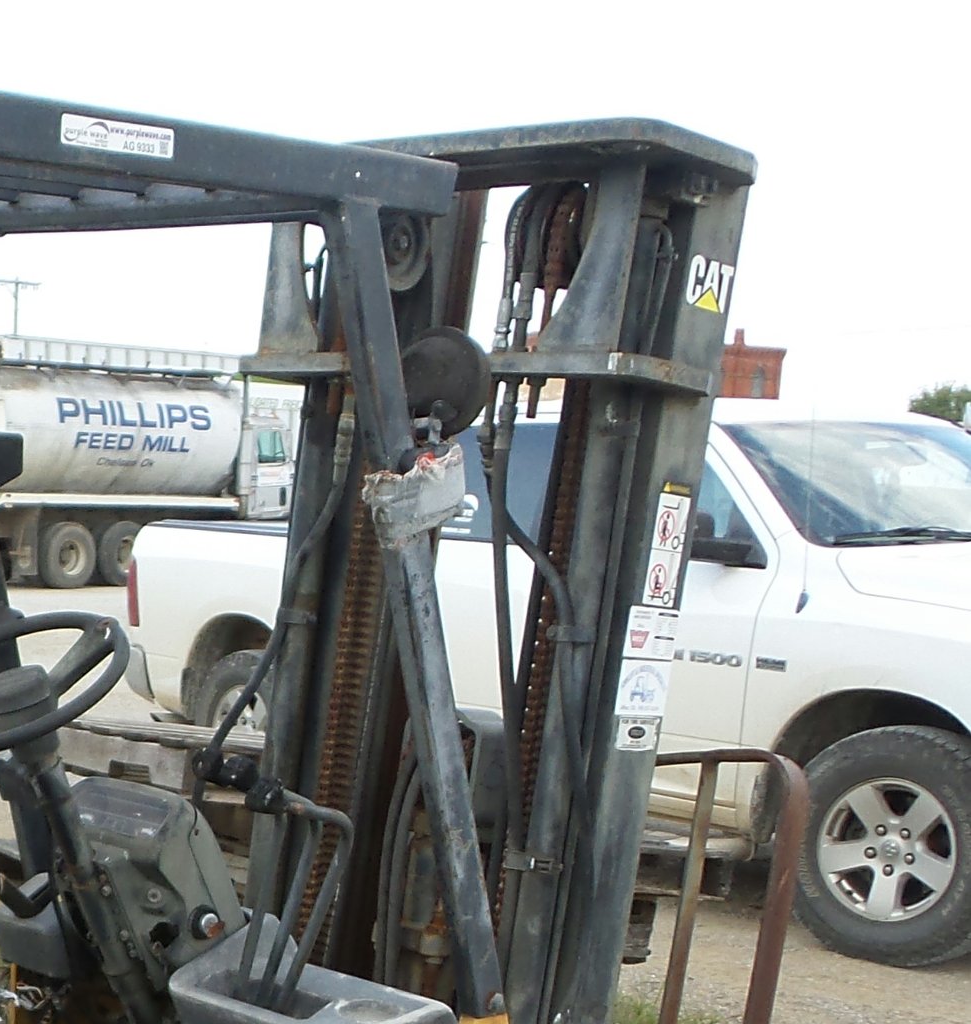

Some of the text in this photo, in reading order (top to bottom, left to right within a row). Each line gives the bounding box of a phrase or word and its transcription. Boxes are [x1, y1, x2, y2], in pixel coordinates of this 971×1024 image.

[65, 126, 108, 140] purple wave
[123, 141, 155, 154] AG 9333
[686, 254, 735, 315] CAT
[56, 397, 212, 431] PHILLIPS
[74, 432, 190, 453] FEED MILL
[690, 651, 742, 668] 1500
